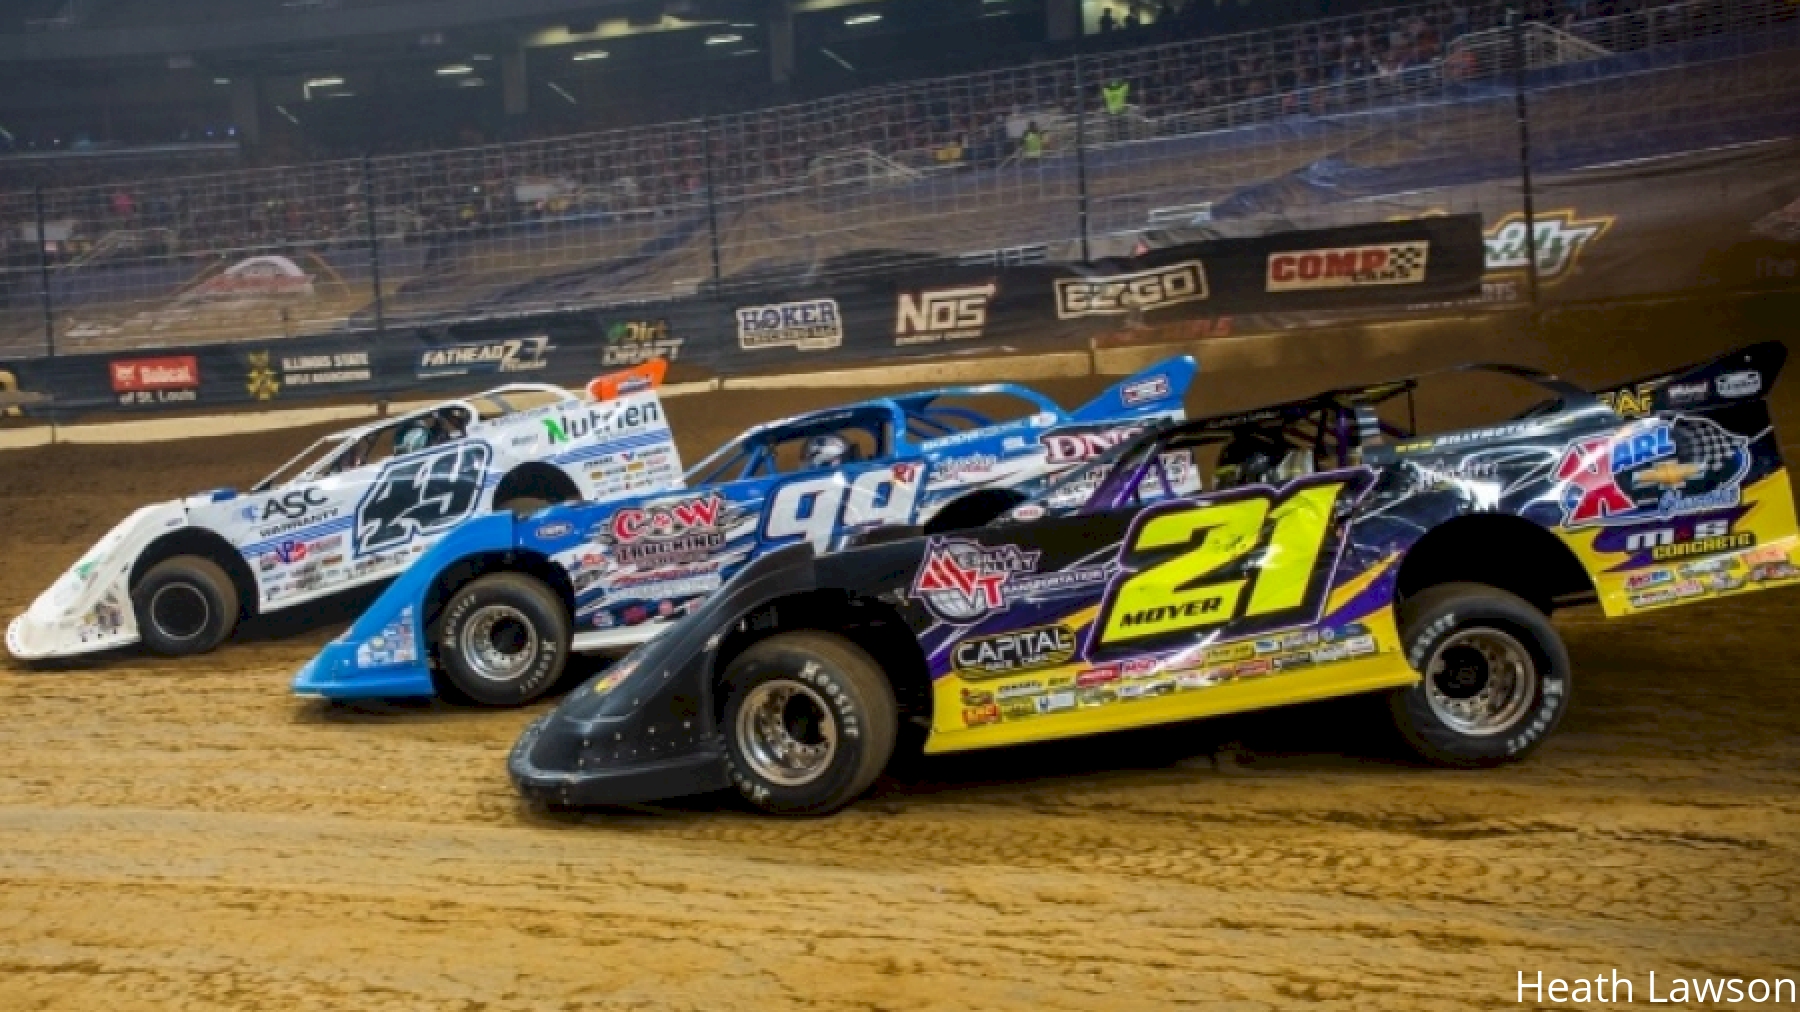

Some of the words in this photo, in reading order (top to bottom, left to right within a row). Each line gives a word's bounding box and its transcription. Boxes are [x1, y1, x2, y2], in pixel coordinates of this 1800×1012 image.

[1270, 250, 1388, 285] COMP
[895, 284, 996, 334] NOS
[159, 388, 198, 403] Louis
[541, 401, 659, 445] Nutrien
[261, 487, 329, 519] ASC
[360, 442, 488, 553] 49
[613, 495, 721, 543] C&W
[766, 462, 922, 558] 99
[1101, 481, 1347, 644] 21
[1119, 596, 1223, 628] MOYER
[956, 626, 1072, 667] CAPITAL
